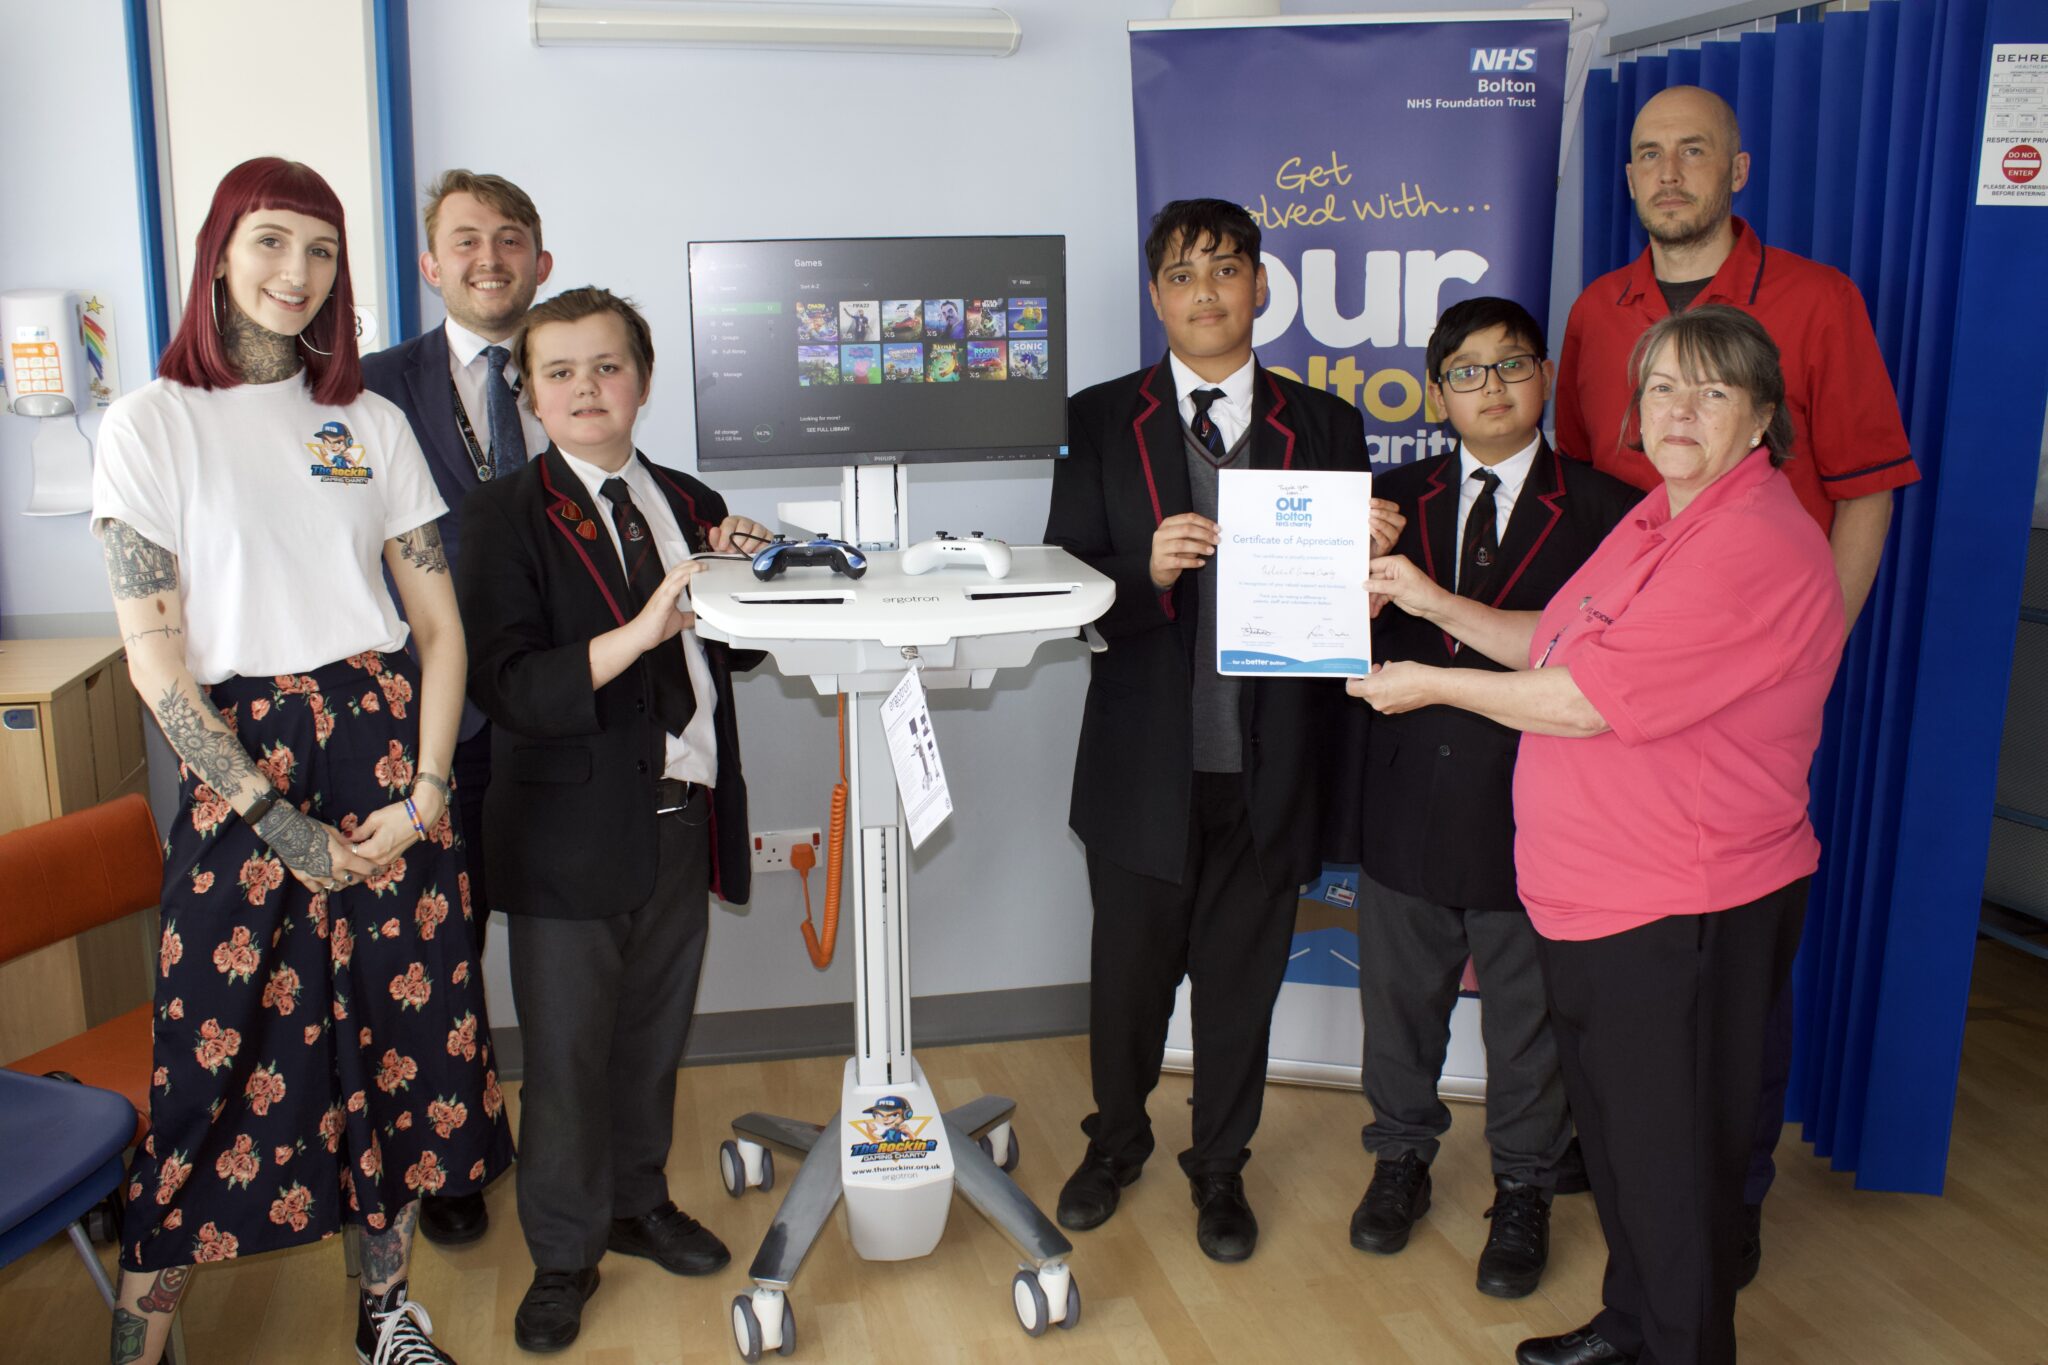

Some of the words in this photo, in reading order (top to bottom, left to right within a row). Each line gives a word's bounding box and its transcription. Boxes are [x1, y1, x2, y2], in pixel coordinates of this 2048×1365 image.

[1472, 48, 1536, 71] NHS
[1478, 77, 1535, 93] Bolton
[1407, 98, 1432, 109] NHS
[1436, 97, 1503, 108] Foundation
[1507, 97, 1536, 107] Trust
[1276, 150, 1352, 193] Get
[794, 258, 822, 268] Games
[1014, 343, 1042, 351] SONIC
[1276, 497, 1312, 511] our
[1276, 512, 1312, 521] Bolton
[1233, 534, 1280, 545] Certificate
[1283, 535, 1293, 545] of
[1297, 536, 1354, 549] Appreciation
[882, 594, 940, 605] ergotron
[1246, 658, 1269, 666] better
[851, 1140, 938, 1156] TheRockinR
[863, 1153, 892, 1161] GAMING
[852, 1164, 941, 1175] www.therockinr.org.uk
